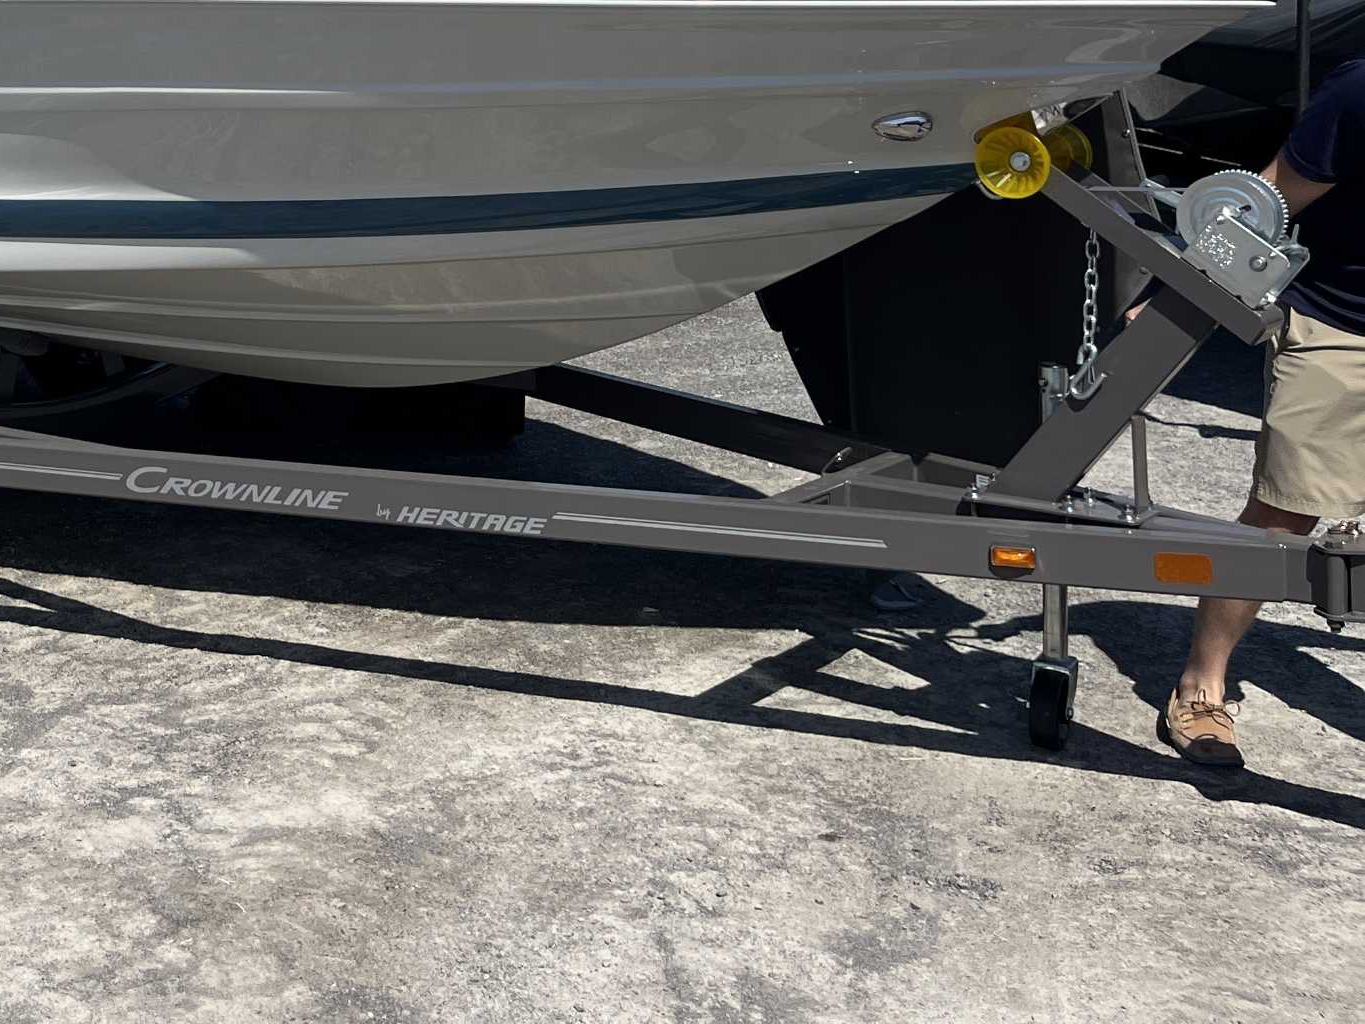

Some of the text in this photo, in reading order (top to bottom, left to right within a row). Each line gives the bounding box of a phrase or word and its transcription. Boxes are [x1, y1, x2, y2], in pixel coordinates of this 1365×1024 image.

[125, 466, 548, 536] CROWNLINE by HERITAGE
